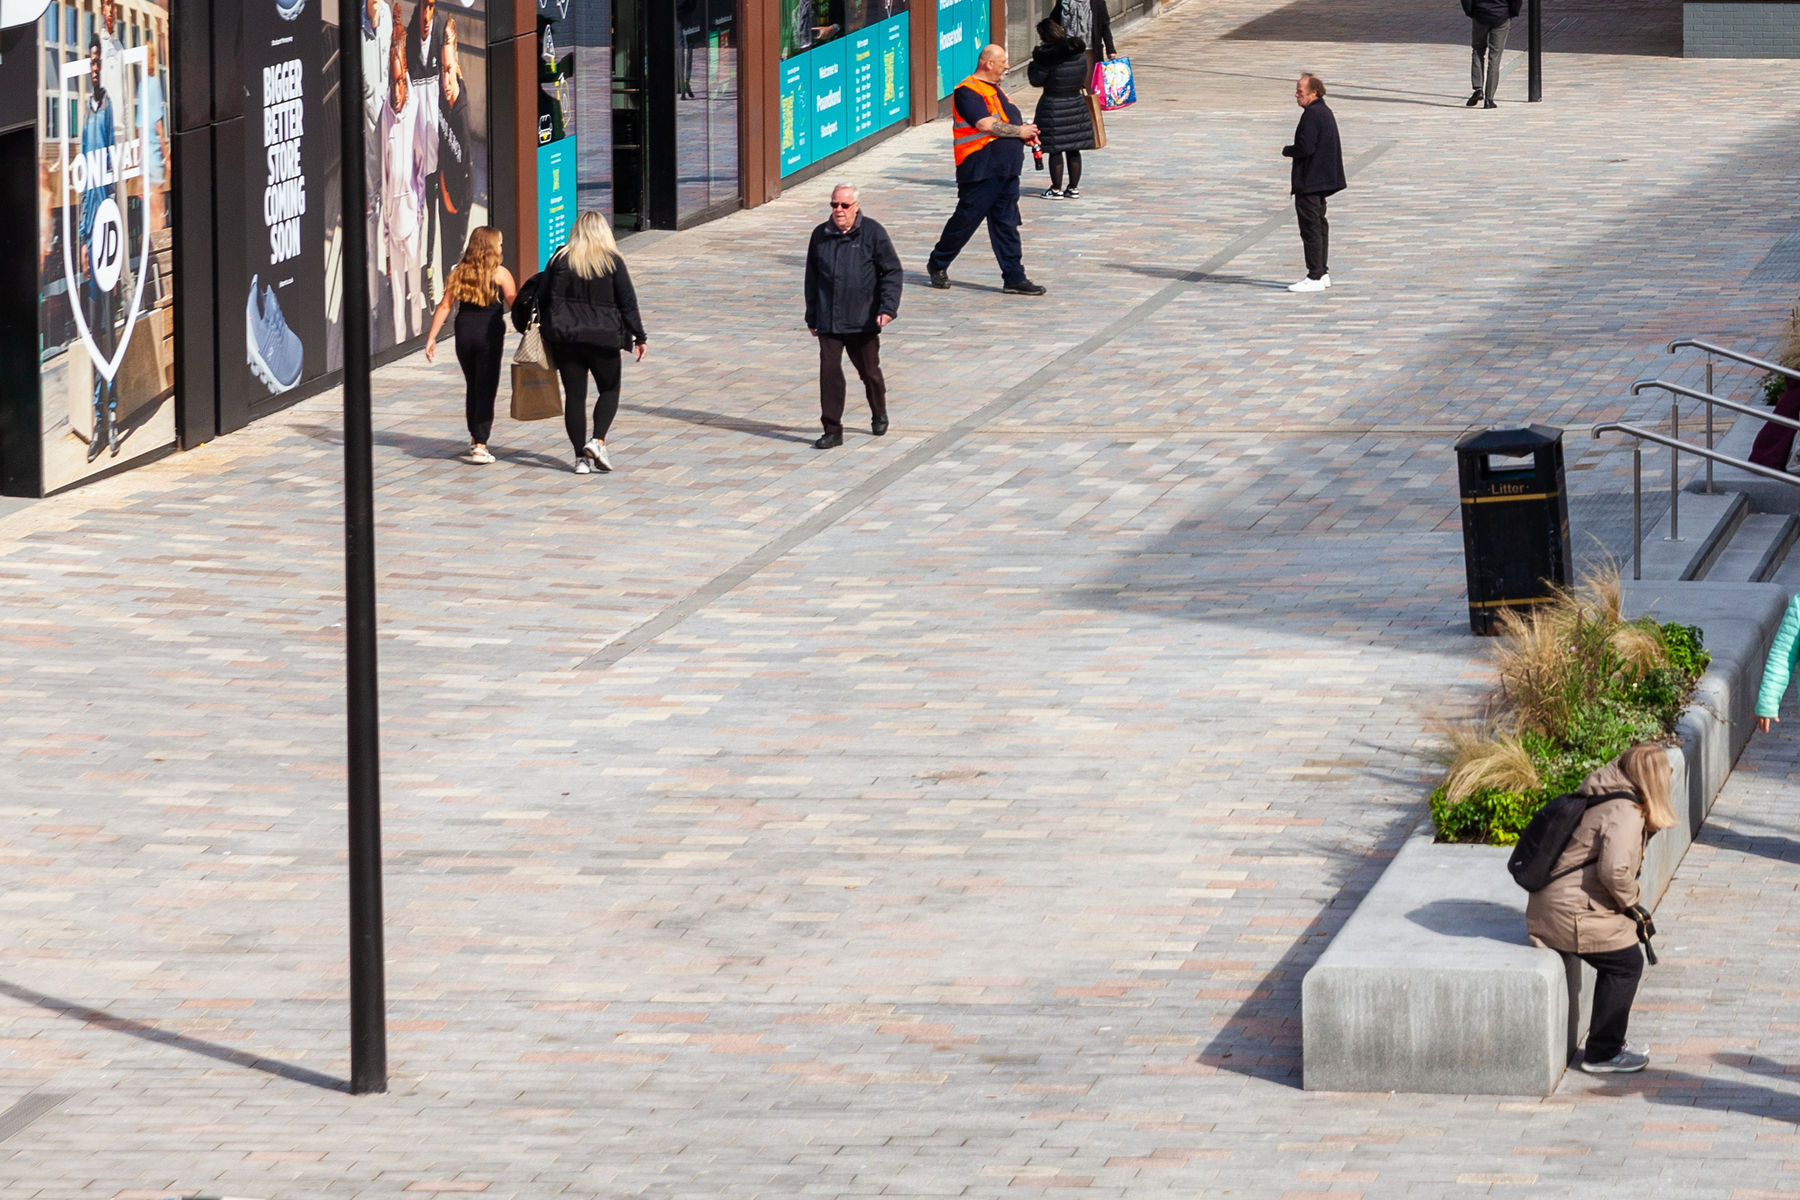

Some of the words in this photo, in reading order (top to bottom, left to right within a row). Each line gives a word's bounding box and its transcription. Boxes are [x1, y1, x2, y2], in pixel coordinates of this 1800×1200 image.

[939, 21, 962, 51] Household
[263, 59, 303, 108] BIGGER
[817, 86, 841, 112] Poundland
[264, 98, 304, 147] BETTER
[72, 143, 121, 193] ONLY
[121, 138, 140, 172] AT
[267, 137, 301, 185] STORE
[264, 175, 306, 226] COMING
[97, 220, 119, 270] JD
[270, 217, 301, 265] SOON
[1491, 483, 1525, 495] Litter
